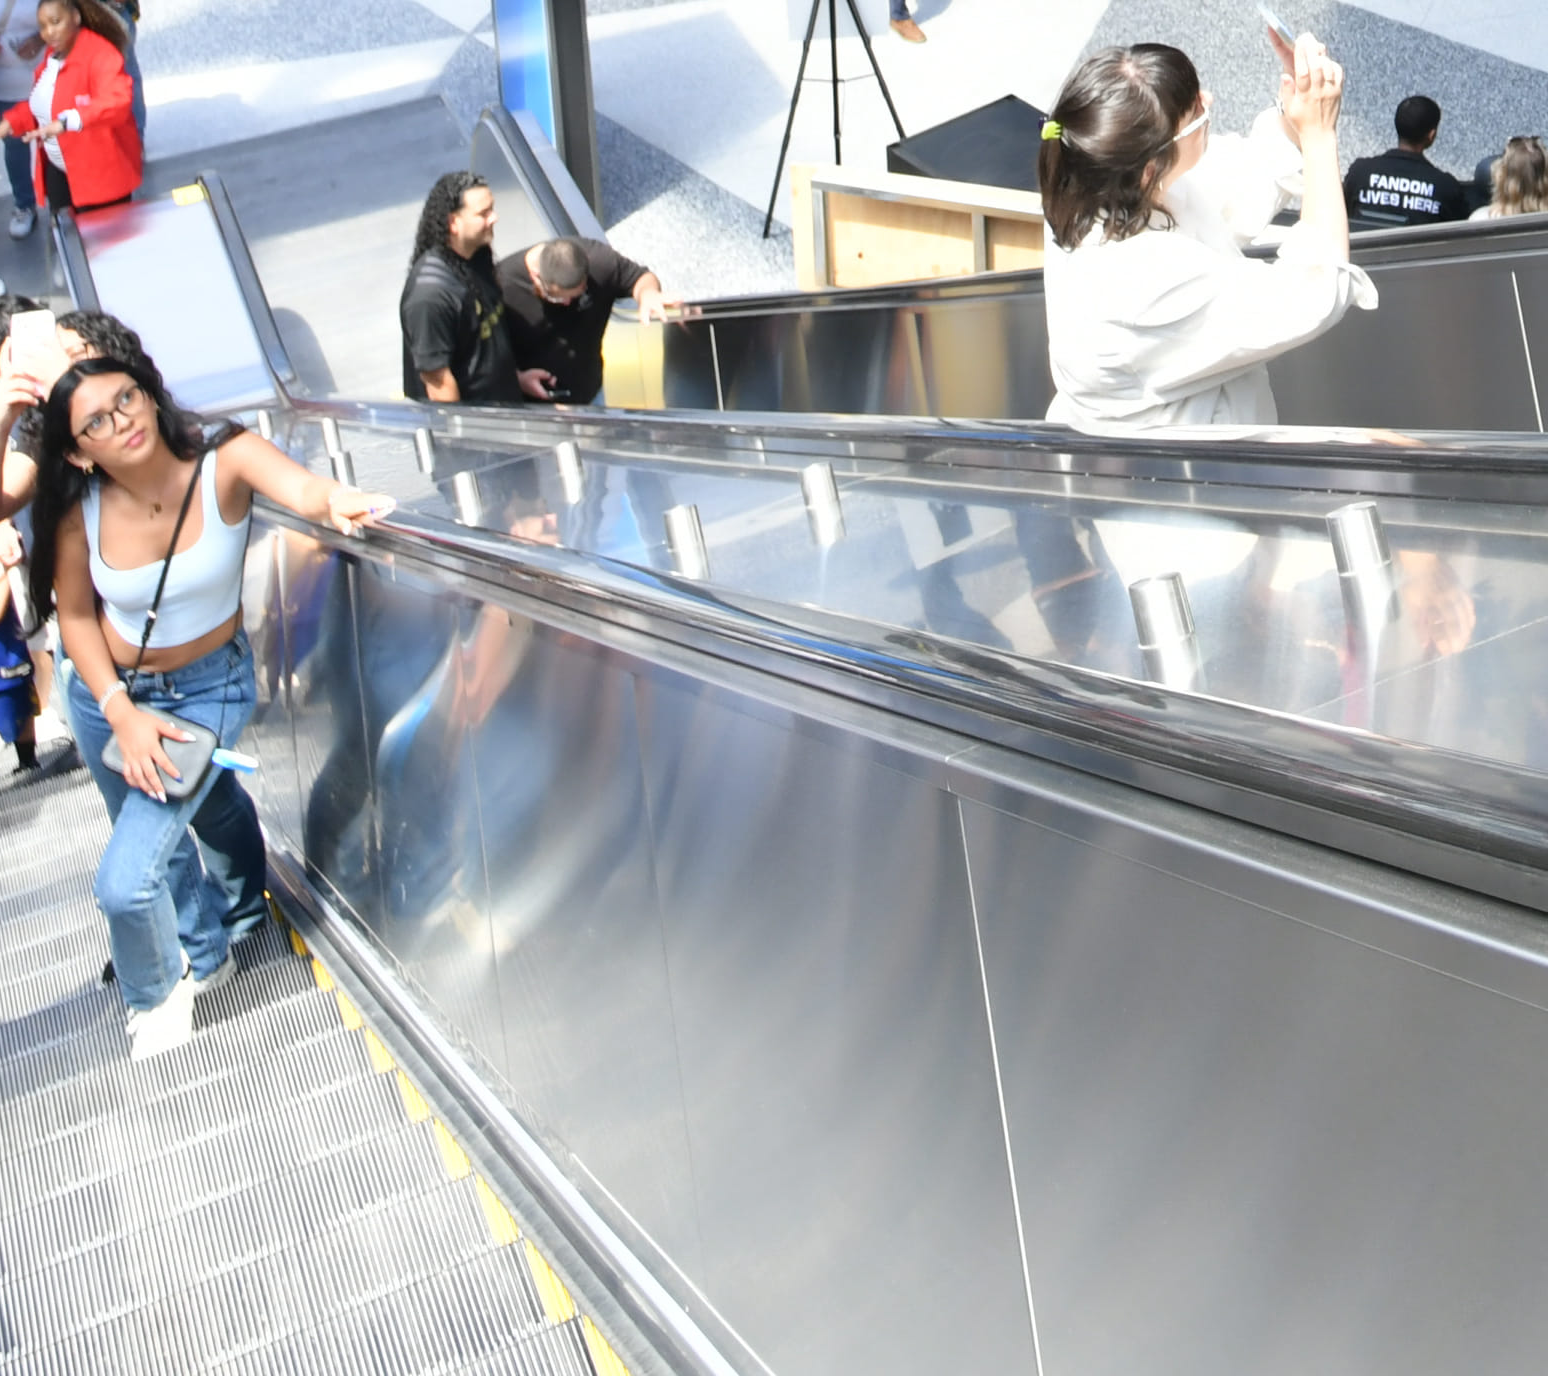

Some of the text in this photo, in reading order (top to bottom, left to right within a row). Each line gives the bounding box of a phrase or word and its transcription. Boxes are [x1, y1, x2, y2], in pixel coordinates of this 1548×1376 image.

[1369, 174, 1434, 197] FANDOM
[1359, 190, 1441, 215] LIVES HERE
